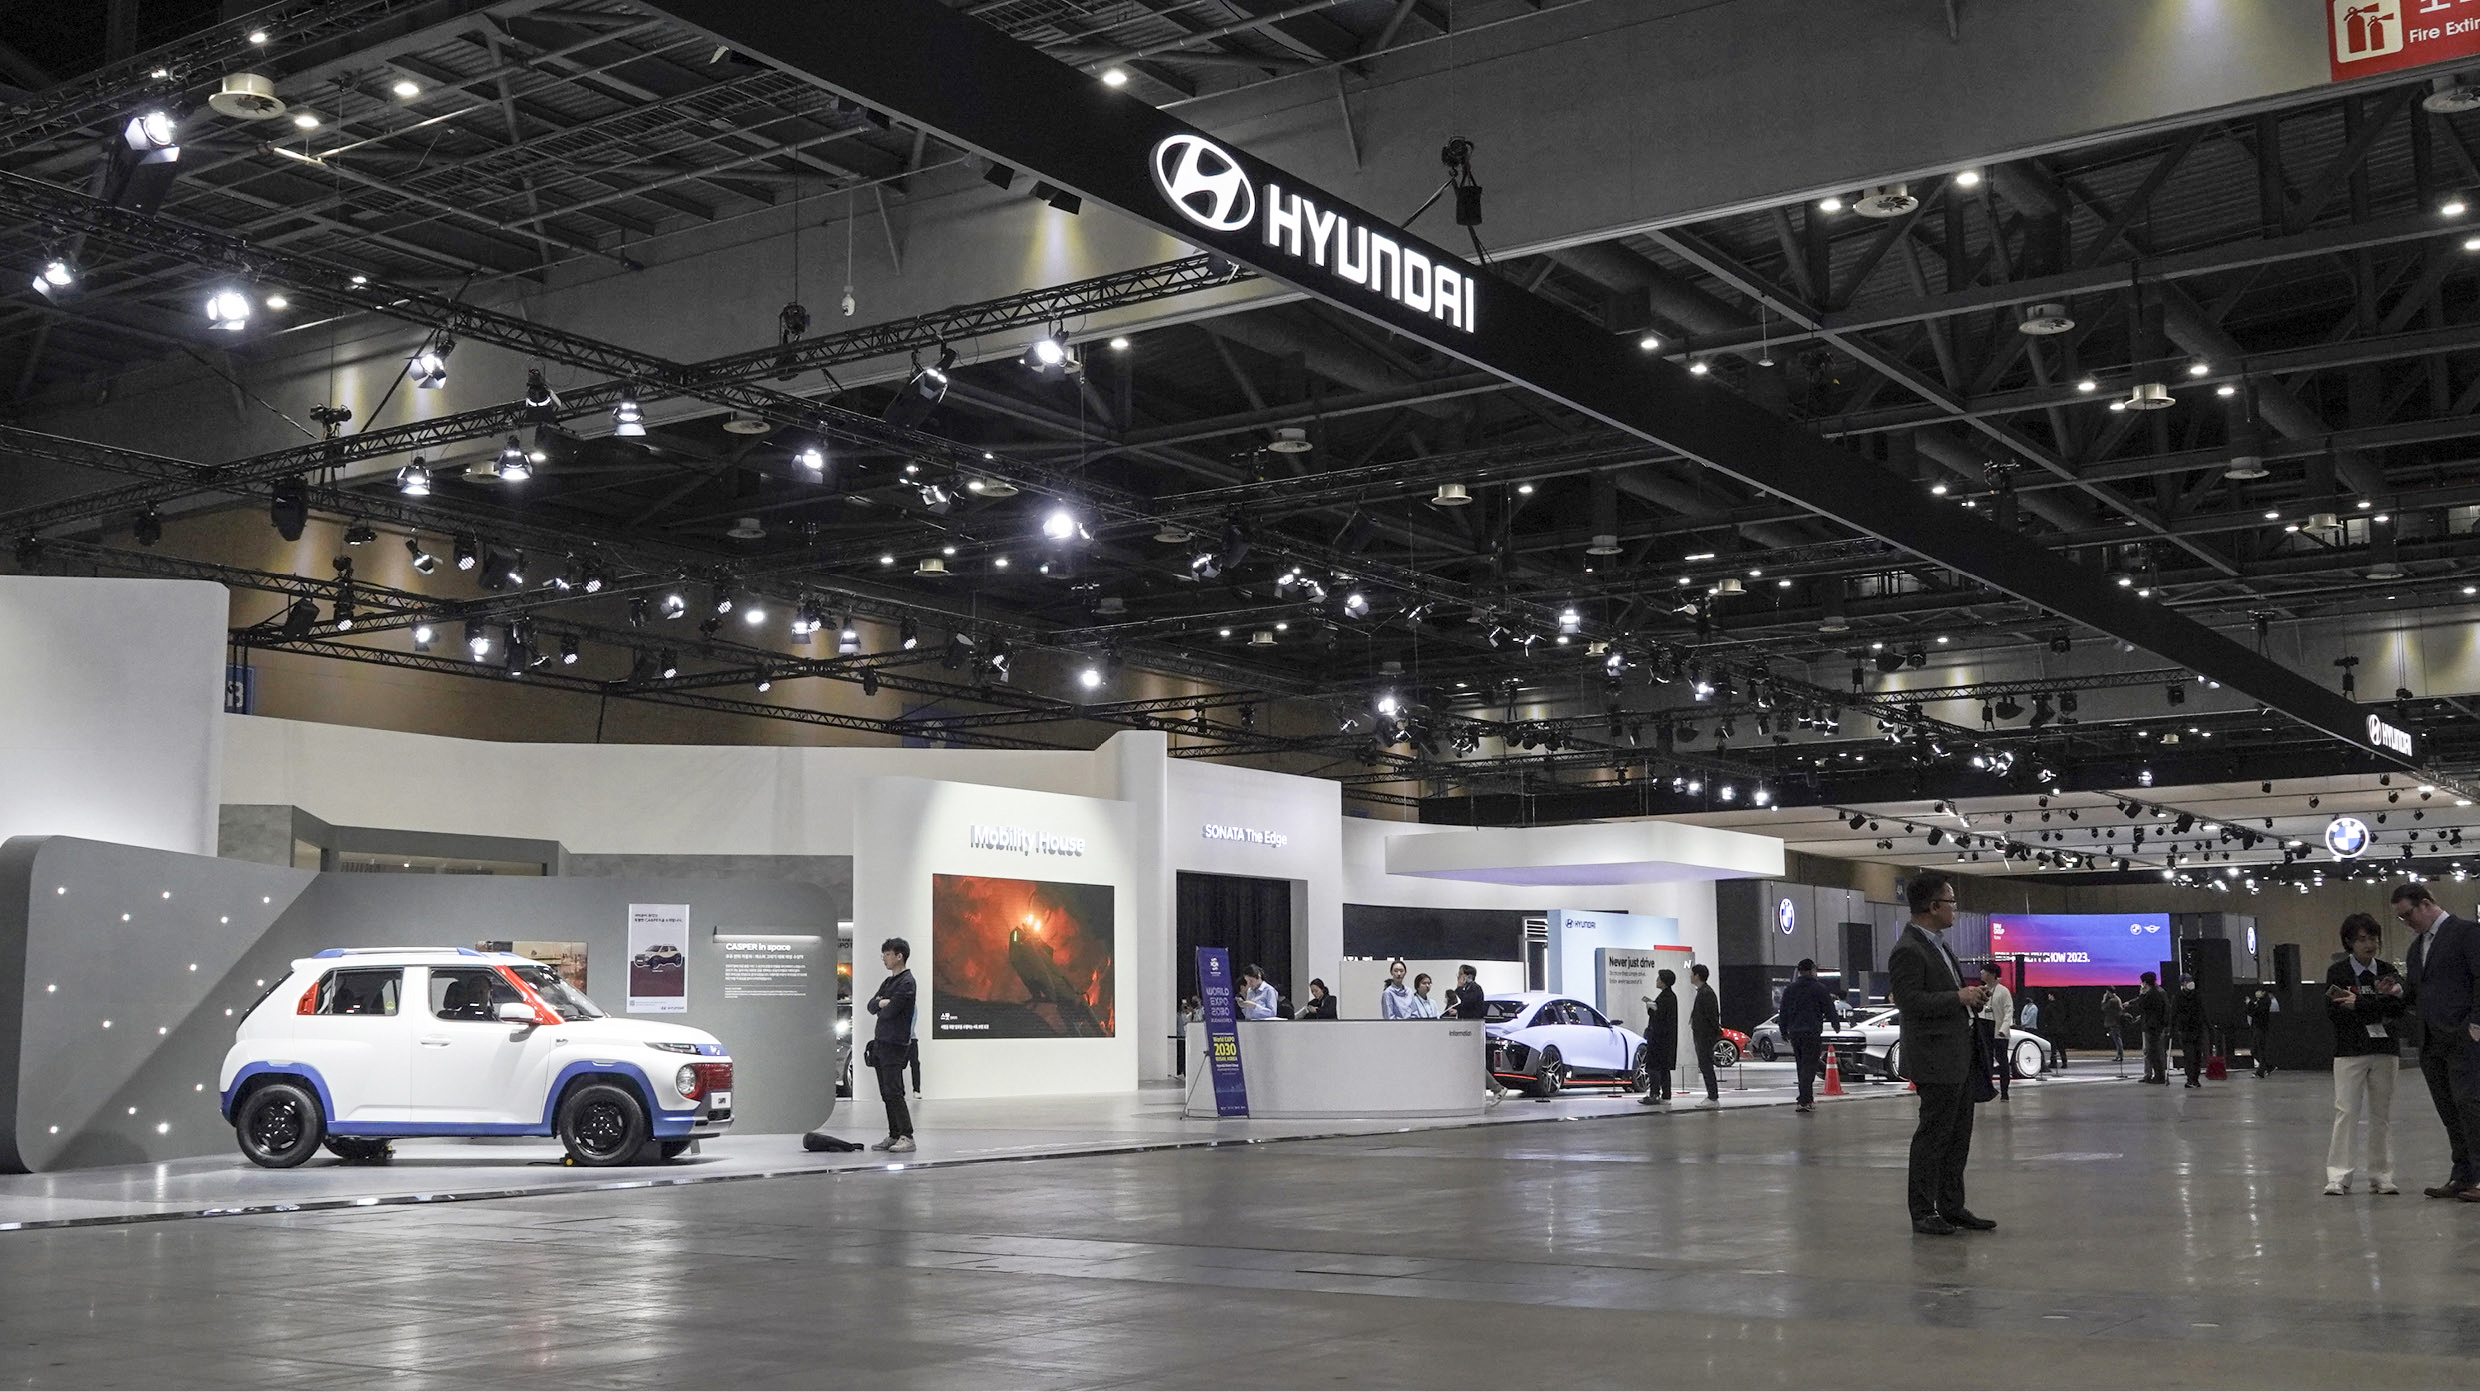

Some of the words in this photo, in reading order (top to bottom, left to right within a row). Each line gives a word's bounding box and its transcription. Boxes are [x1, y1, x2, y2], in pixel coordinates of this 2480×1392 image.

[2410, 28, 2441, 43] Fire
[1264, 183, 1476, 334] HYUNDAI
[972, 823, 1037, 854] Mobility
[1038, 830, 1086, 856] House
[1203, 823, 1245, 842] SONATA
[1245, 828, 1264, 844] The
[1264, 830, 1288, 848] Edge
[725, 943, 758, 951] CASPER
[759, 942, 767, 951] in
[767, 943, 792, 953] space
[1609, 956, 1628, 968] Never
[1627, 956, 1640, 969] just
[1639, 956, 1655, 969] drive
[1683, 959, 1692, 969] N
[2066, 952, 2091, 963] 2023.
[1213, 1042, 1237, 1056] 2030
